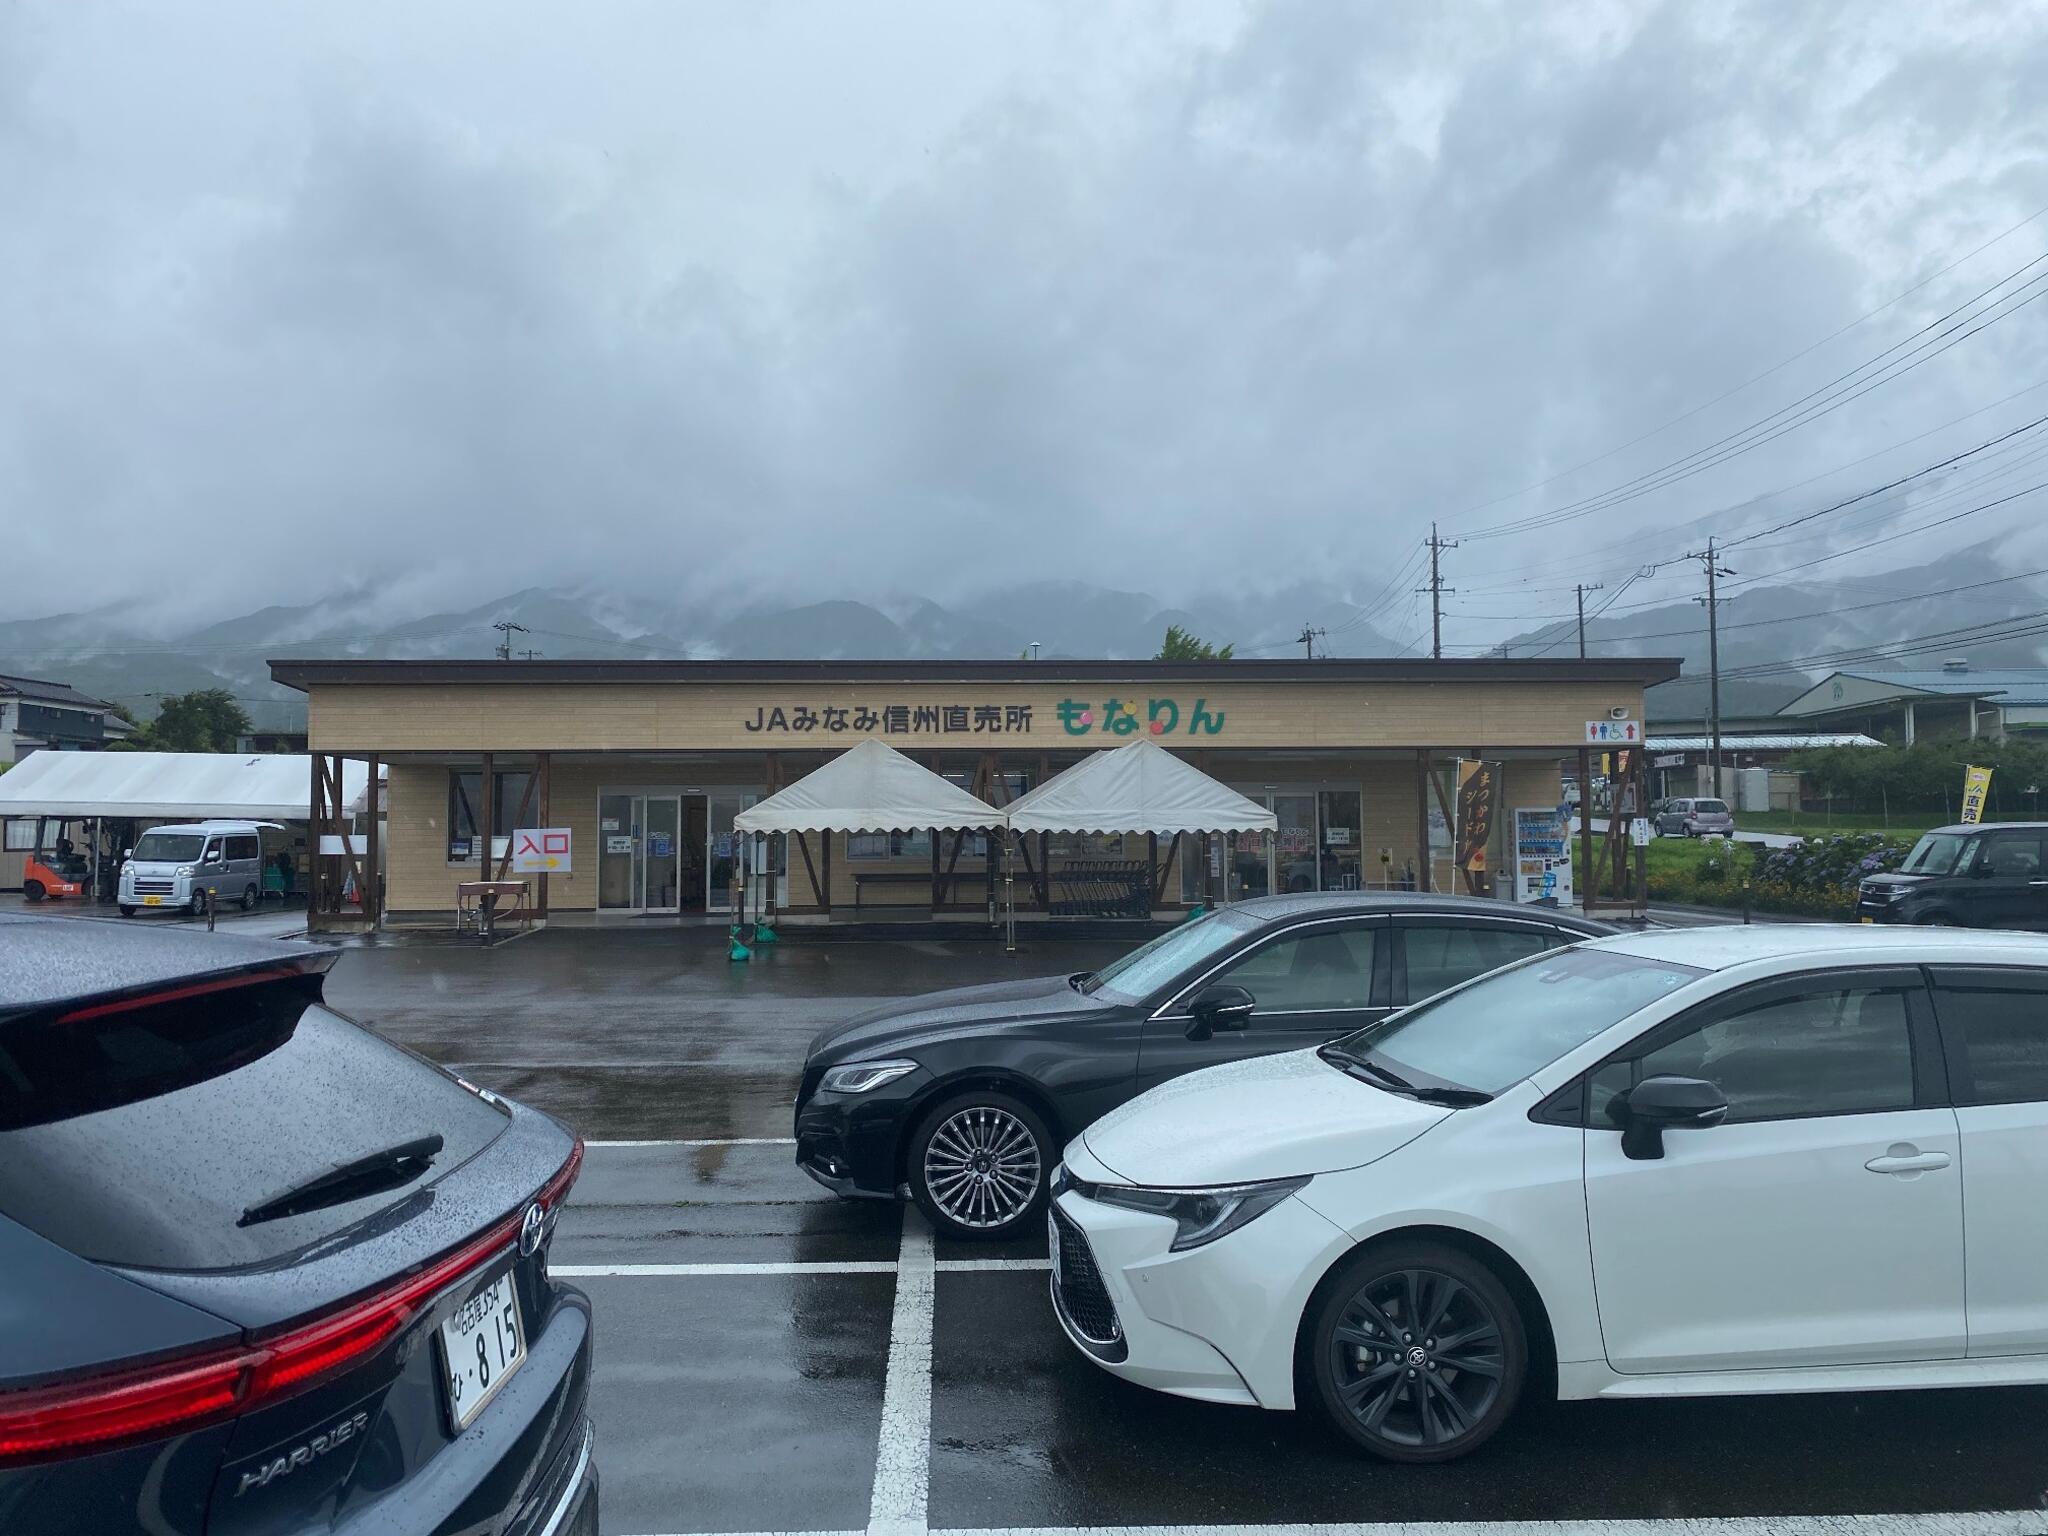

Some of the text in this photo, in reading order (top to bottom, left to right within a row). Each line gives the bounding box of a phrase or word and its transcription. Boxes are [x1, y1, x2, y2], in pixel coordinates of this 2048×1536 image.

[745, 698, 1225, 736] JAみなみ信州直売所 もなりん
[1963, 796, 1981, 824] 直売
[518, 834, 569, 855] 入口
[232, 1411, 369, 1498] HARRIER
